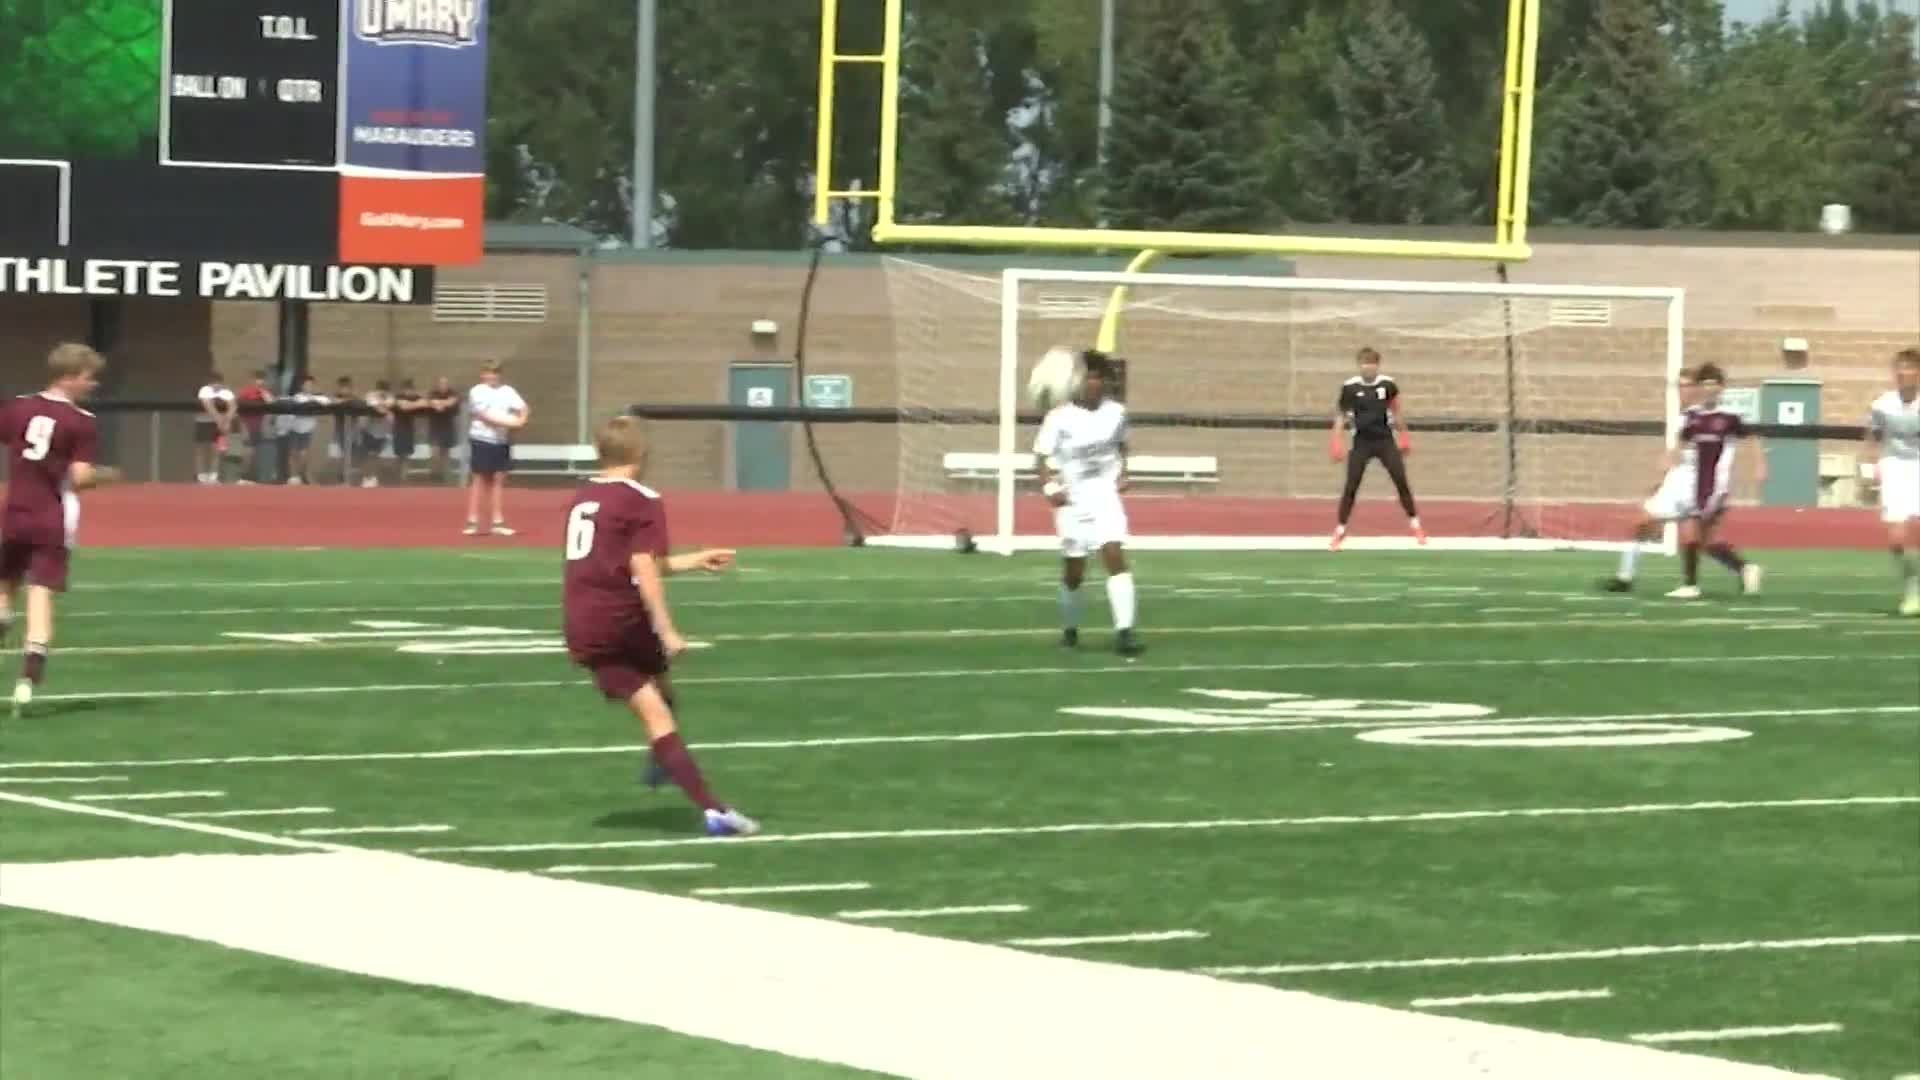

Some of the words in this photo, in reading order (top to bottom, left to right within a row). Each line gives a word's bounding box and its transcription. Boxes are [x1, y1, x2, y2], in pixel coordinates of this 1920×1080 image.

[172, 74, 217, 98] BALL
[217, 76, 247, 99] ON
[277, 79, 322, 102] QTR
[353, 127, 475, 147] MARAUDERS
[200, 262, 413, 302] PAVILION
[22, 415, 56, 461] 9
[566, 501, 600, 560] 6
